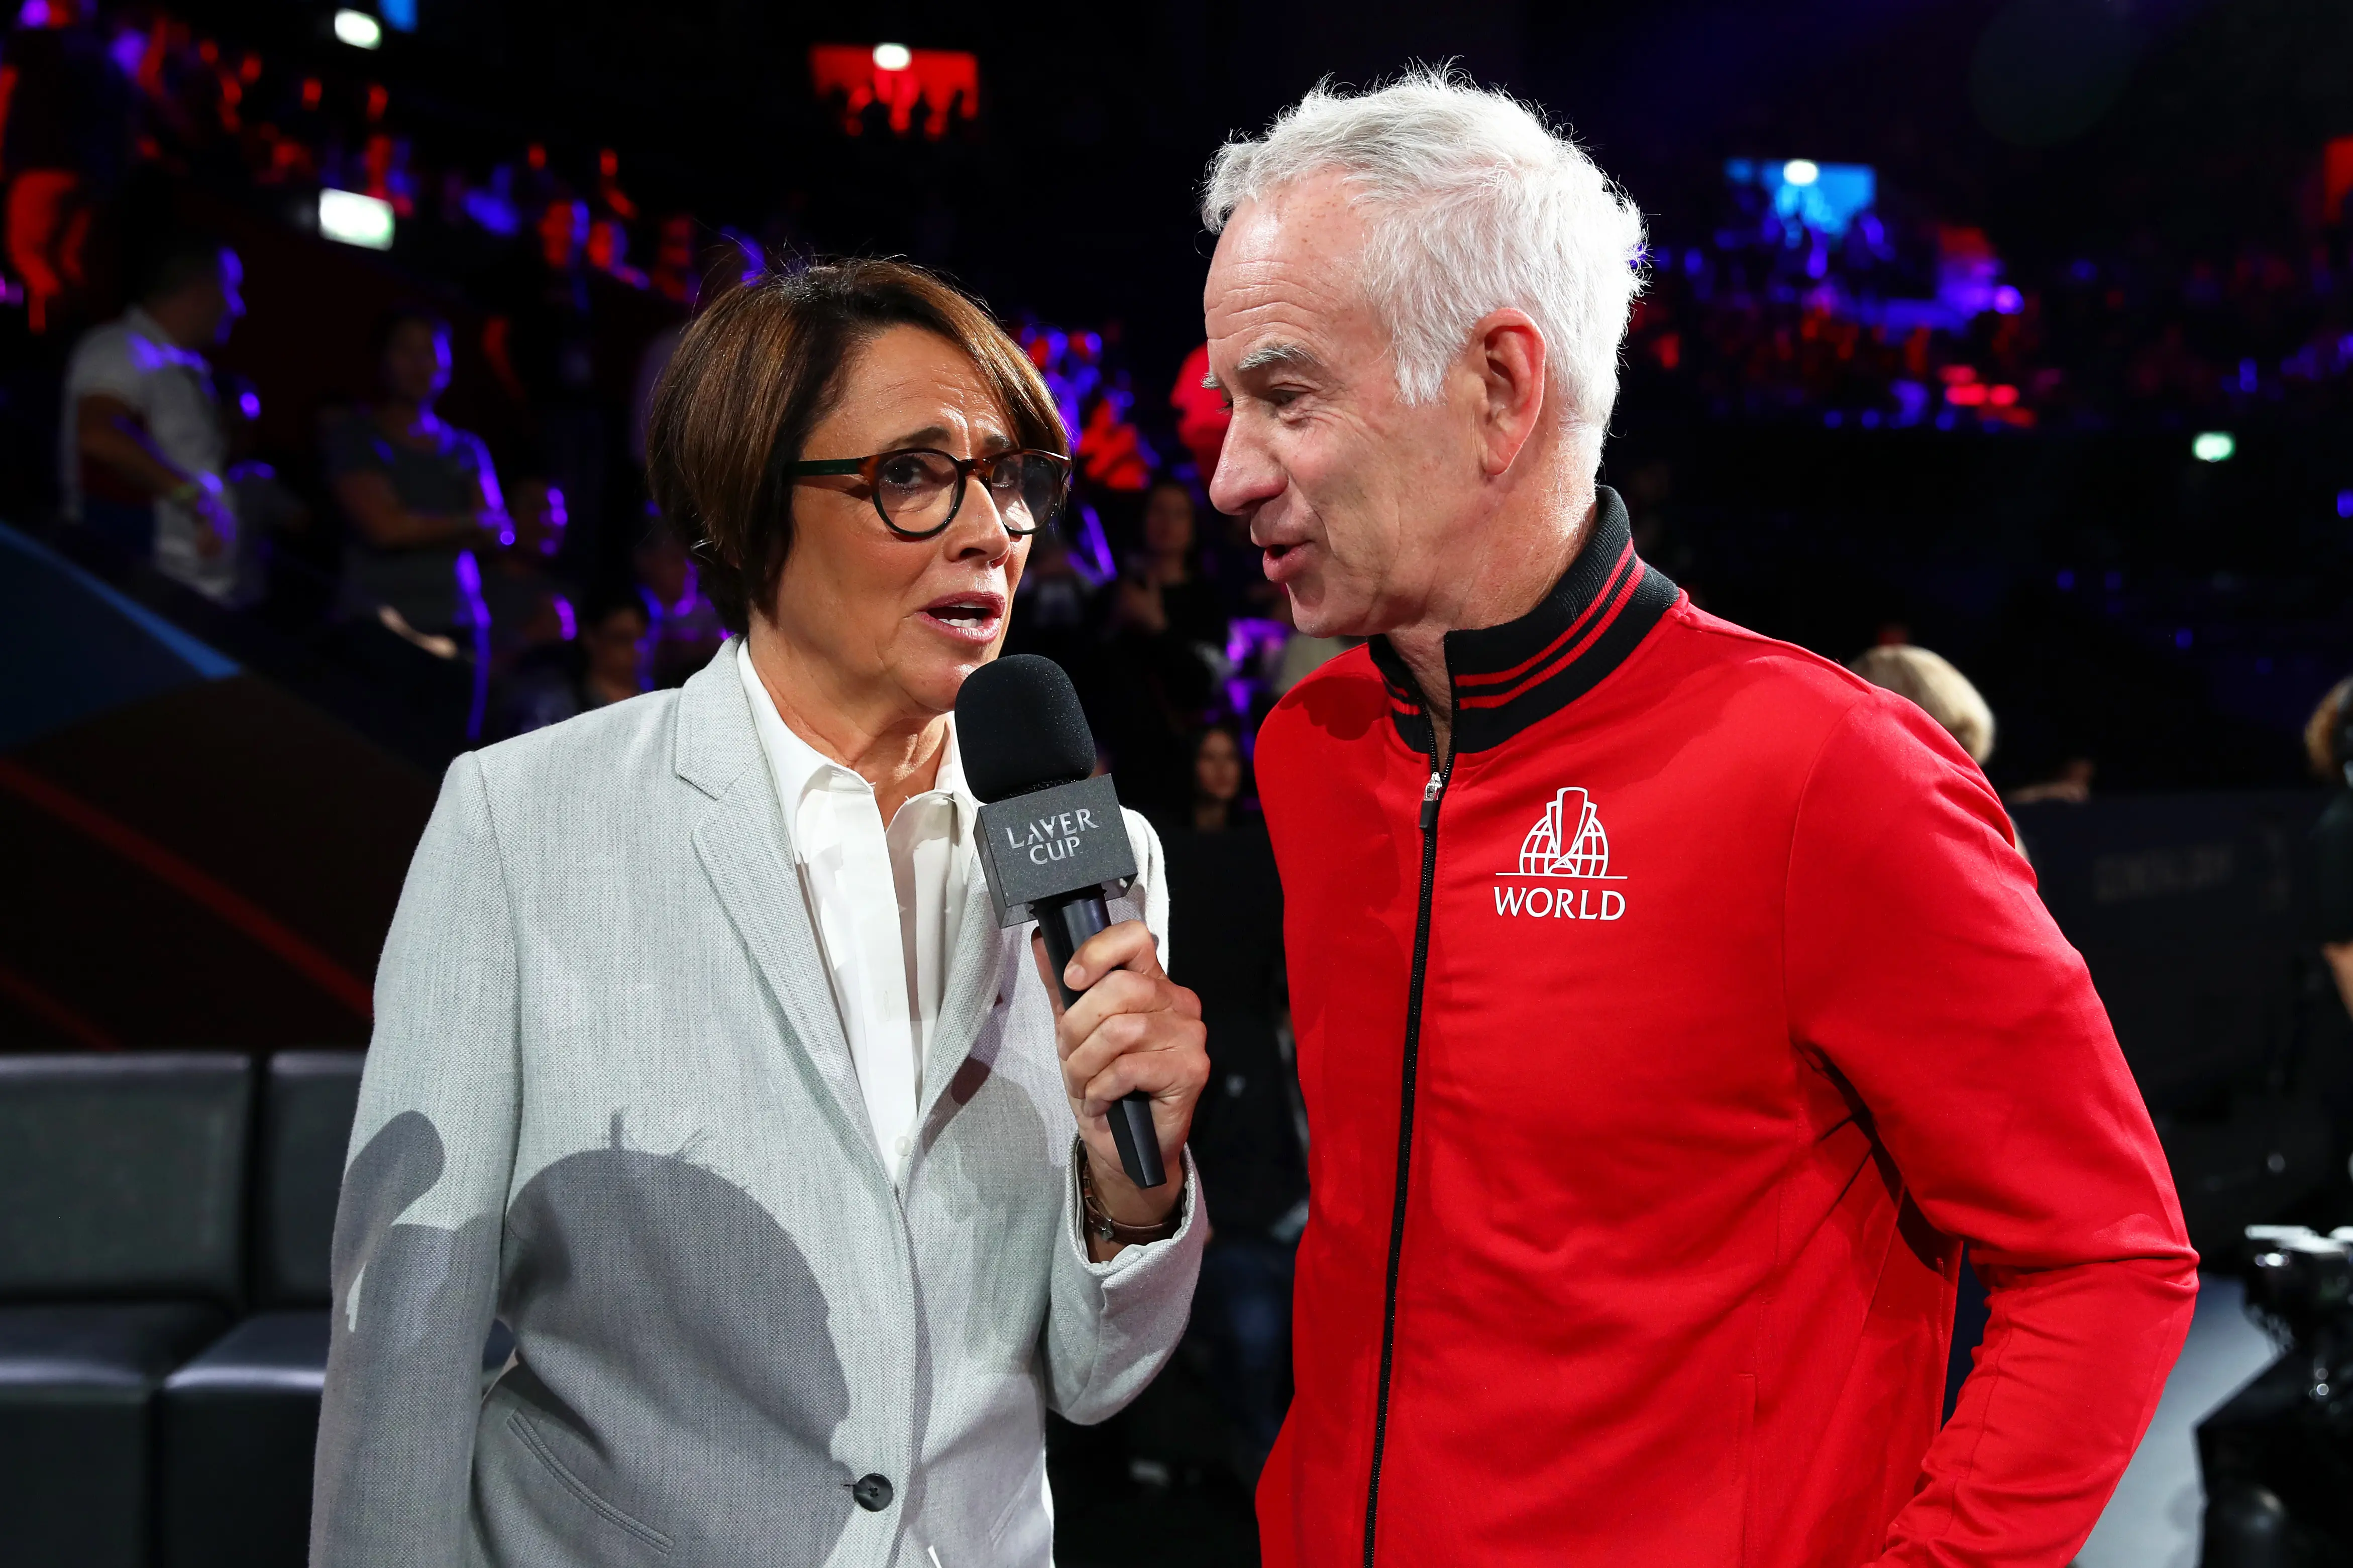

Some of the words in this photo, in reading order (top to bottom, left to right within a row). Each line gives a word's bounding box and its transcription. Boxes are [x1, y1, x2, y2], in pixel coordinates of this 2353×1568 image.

[1004, 808, 1100, 849] LAVER
[1029, 836, 1081, 865] CUP
[1493, 886, 1626, 921] WORLD
